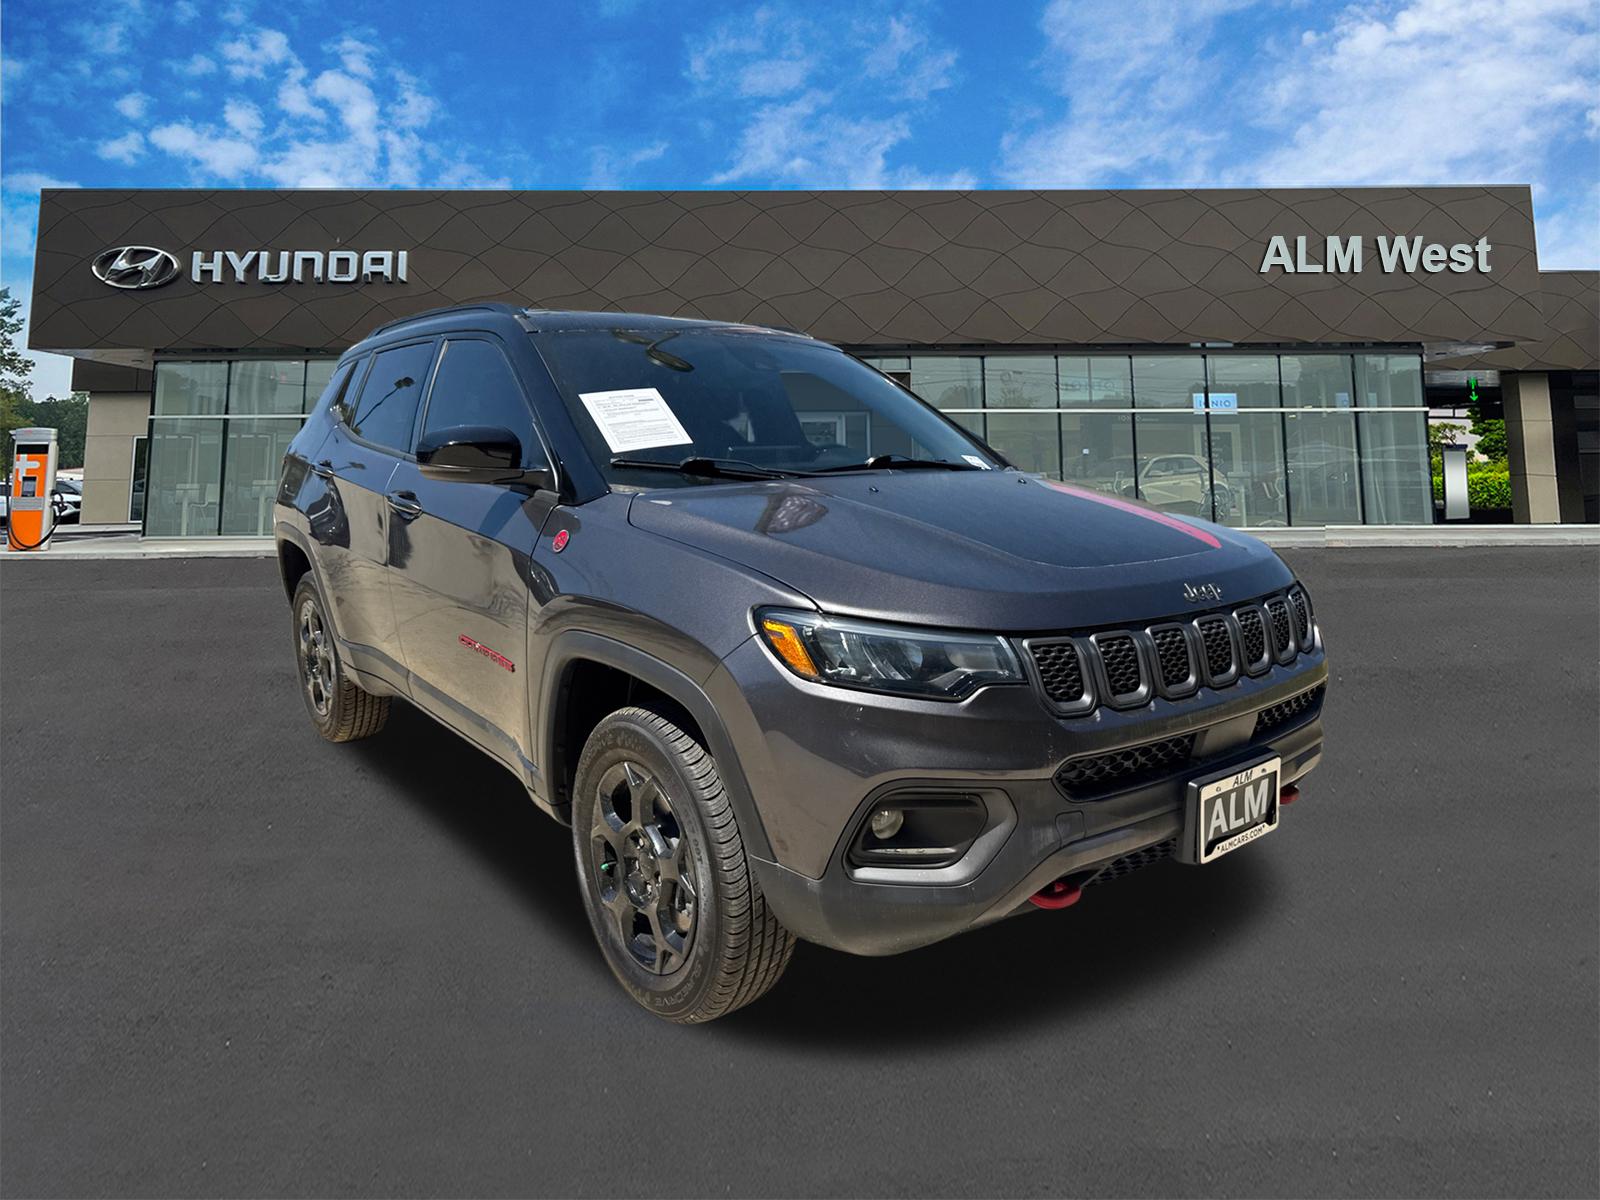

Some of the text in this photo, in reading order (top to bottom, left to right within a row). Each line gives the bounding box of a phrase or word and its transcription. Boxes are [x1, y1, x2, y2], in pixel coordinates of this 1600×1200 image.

[191, 250, 408, 283] HYUNDAI
[1260, 235, 1492, 273] ALM West
[1183, 583, 1222, 602] Jeep
[1233, 769, 1254, 788] ALM
[1208, 778, 1269, 841] ALM
[1220, 827, 1263, 853] ALMCARS.COM
